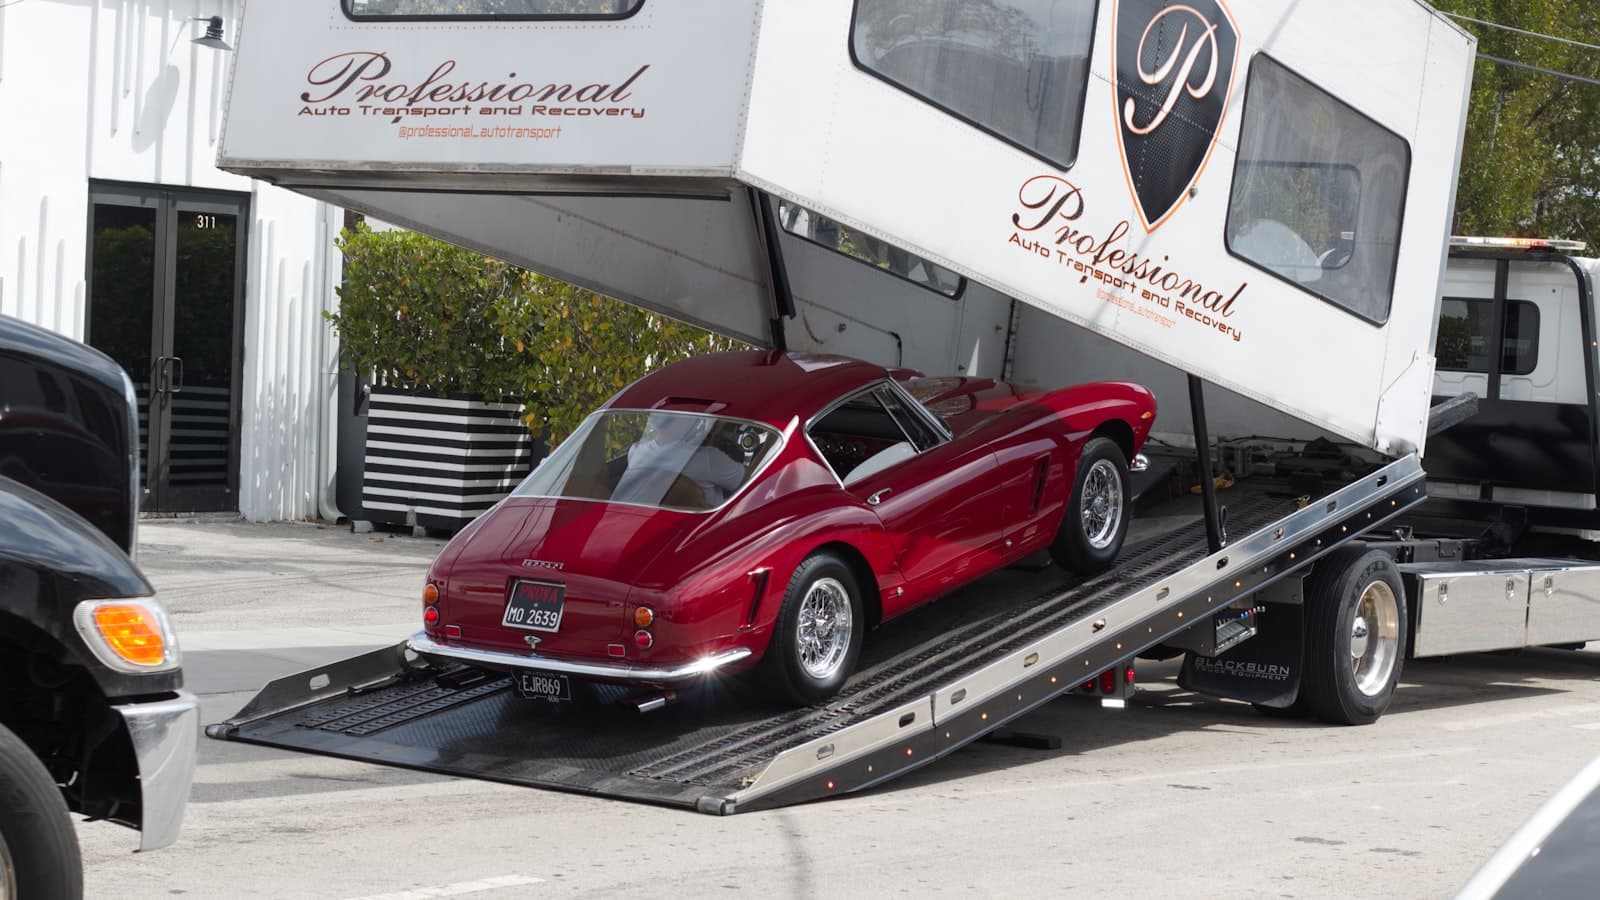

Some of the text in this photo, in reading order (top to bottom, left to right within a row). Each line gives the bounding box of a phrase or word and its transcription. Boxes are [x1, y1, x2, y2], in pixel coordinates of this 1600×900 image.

[300, 51, 651, 124] Professional
[298, 105, 646, 119] Auto Transport and Recovery
[399, 125, 562, 139] @professional_autotransport
[197, 214, 216, 229] 311
[1012, 175, 1248, 318] Professional
[1008, 232, 1051, 259] Auto
[1056, 250, 1137, 294] Transport
[1141, 288, 1170, 309] and
[1174, 300, 1242, 342] Recovery
[507, 607, 558, 627] MO 2639
[1195, 657, 1289, 675] BLACKBURN
[522, 675, 560, 695] EJR869
[1231, 671, 1287, 681] EQUIPMENT
